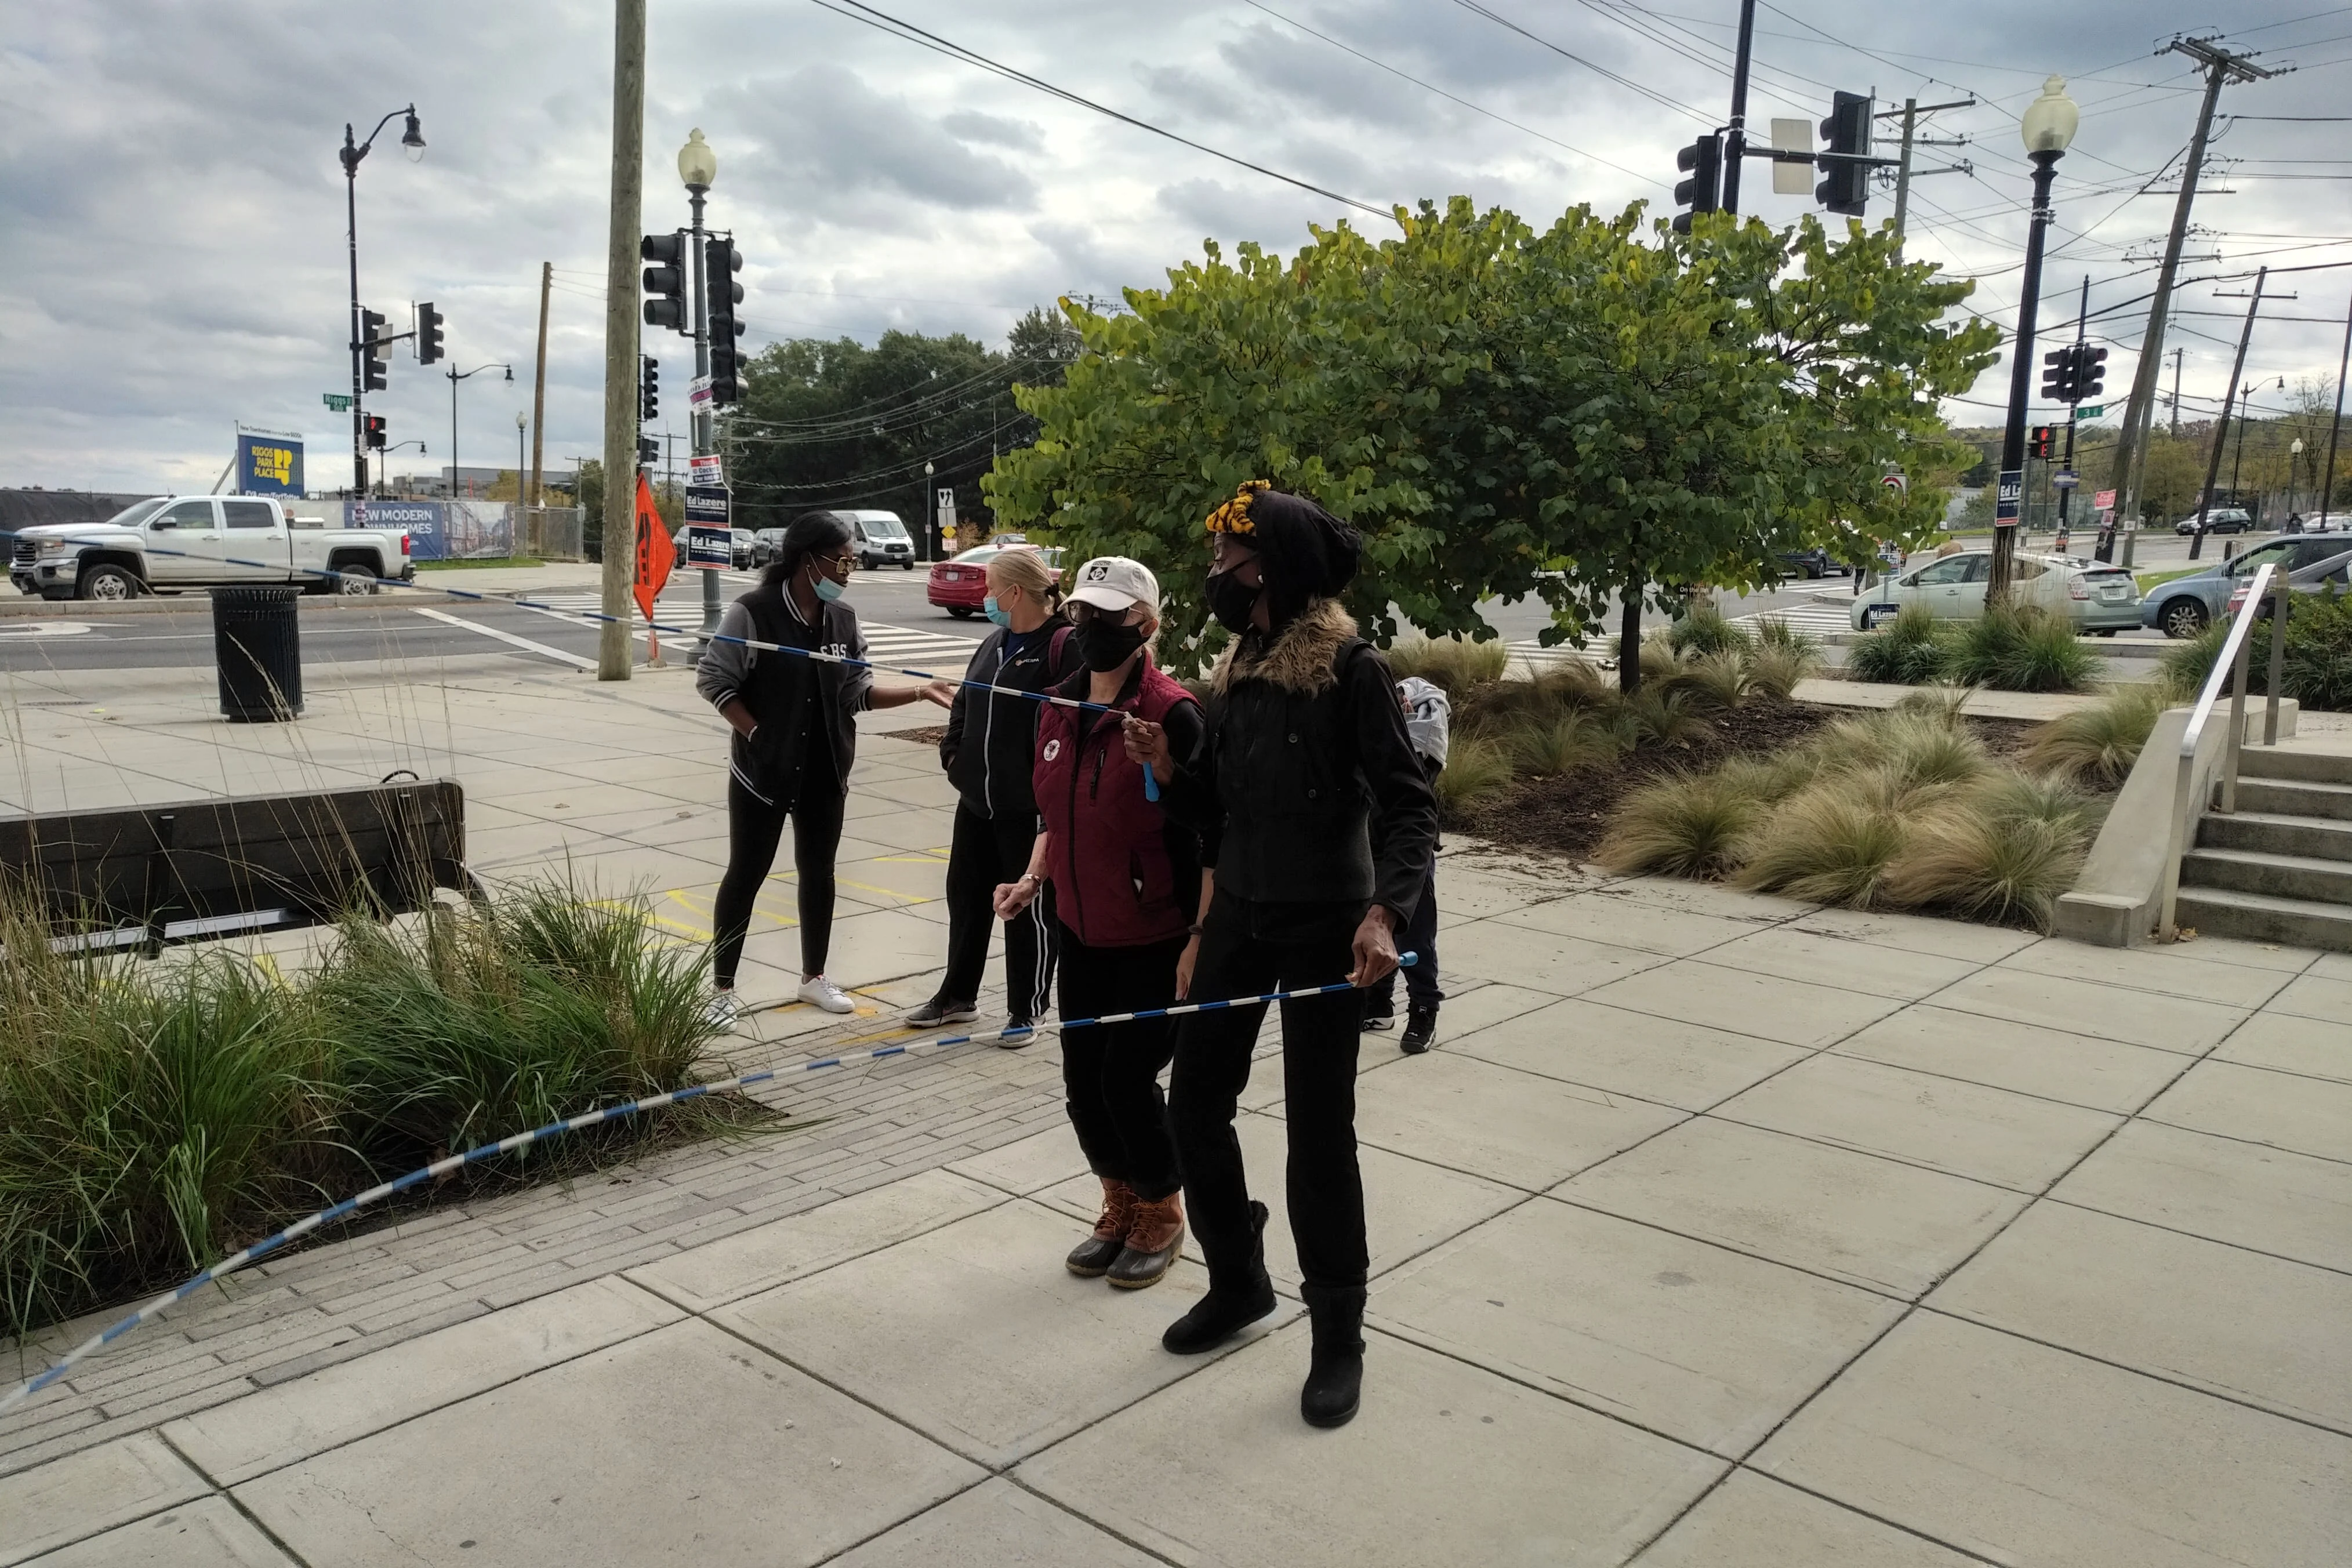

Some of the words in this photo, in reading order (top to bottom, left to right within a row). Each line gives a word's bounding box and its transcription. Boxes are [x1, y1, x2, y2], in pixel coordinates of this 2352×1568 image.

[325, 395, 346, 405] Riggs
[2084, 408, 2090, 417] 3
[252, 445, 273, 457] RIGGS
[256, 457, 273, 467] PARK
[254, 466, 274, 478] PLACE
[2000, 485, 2010, 497] Ed
[687, 495, 696, 505] Ed
[697, 496, 727, 507] Lazere
[382, 509, 433, 521] MODERN
[691, 536, 703, 546] Ed
[705, 538, 729, 549] Lazere
